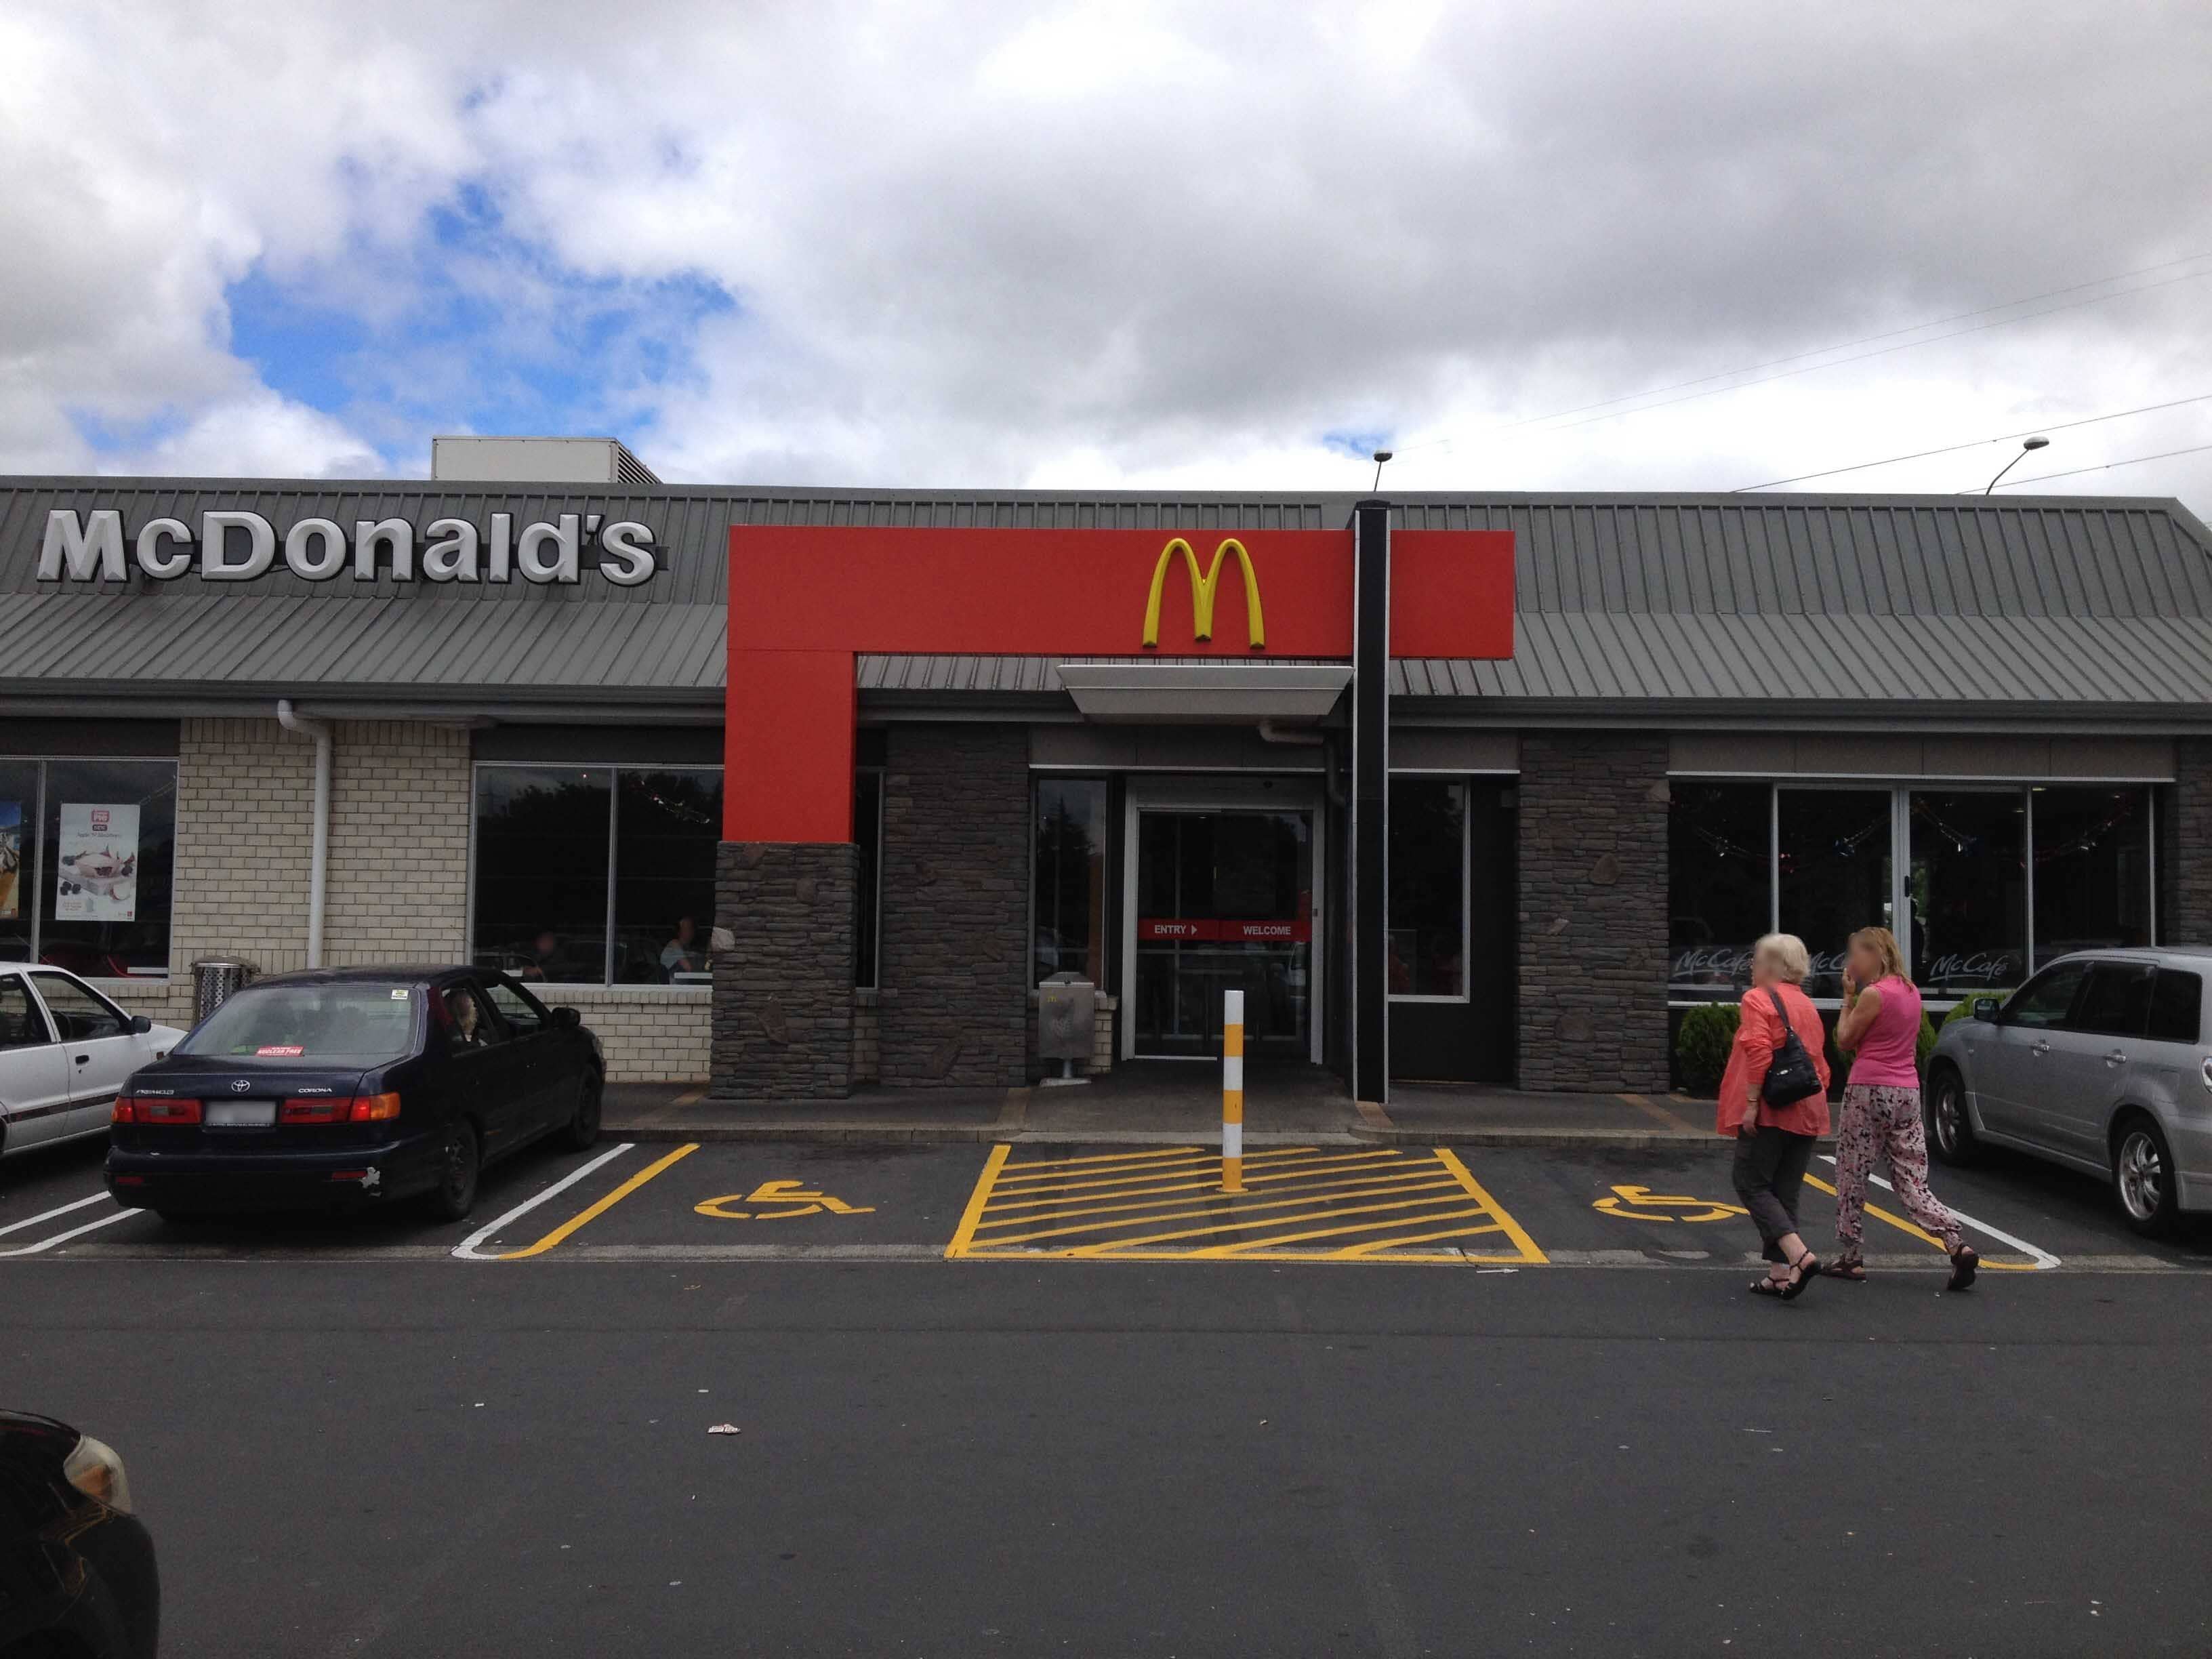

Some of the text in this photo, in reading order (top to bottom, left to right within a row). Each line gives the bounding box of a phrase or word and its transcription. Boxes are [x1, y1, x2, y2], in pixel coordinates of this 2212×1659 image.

[37, 509, 657, 587] McDonald's
[1154, 924, 1187, 935] ENTRY
[1243, 926, 1291, 935] WELCOME
